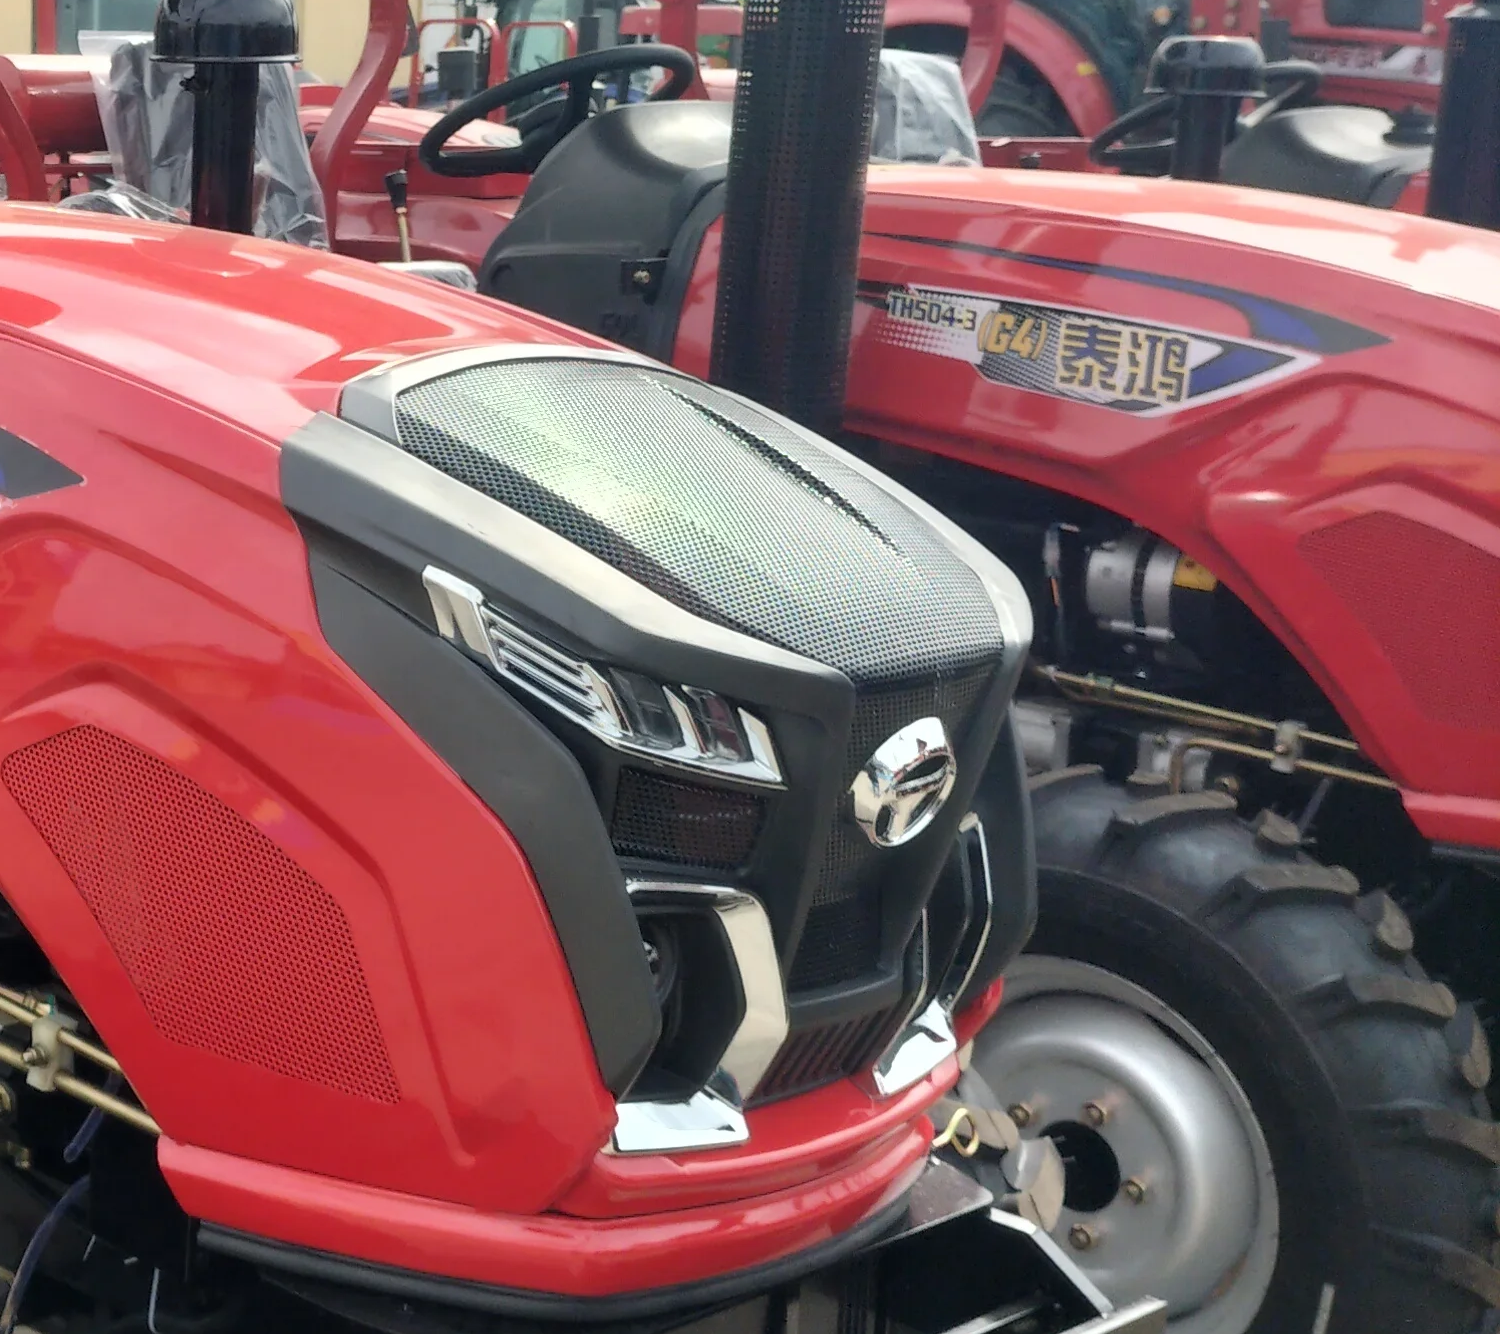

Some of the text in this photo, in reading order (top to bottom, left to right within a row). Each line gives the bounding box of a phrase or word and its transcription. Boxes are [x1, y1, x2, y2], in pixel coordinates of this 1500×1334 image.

[887, 291, 1191, 405] TH504-3 (G4) 泰鸿
